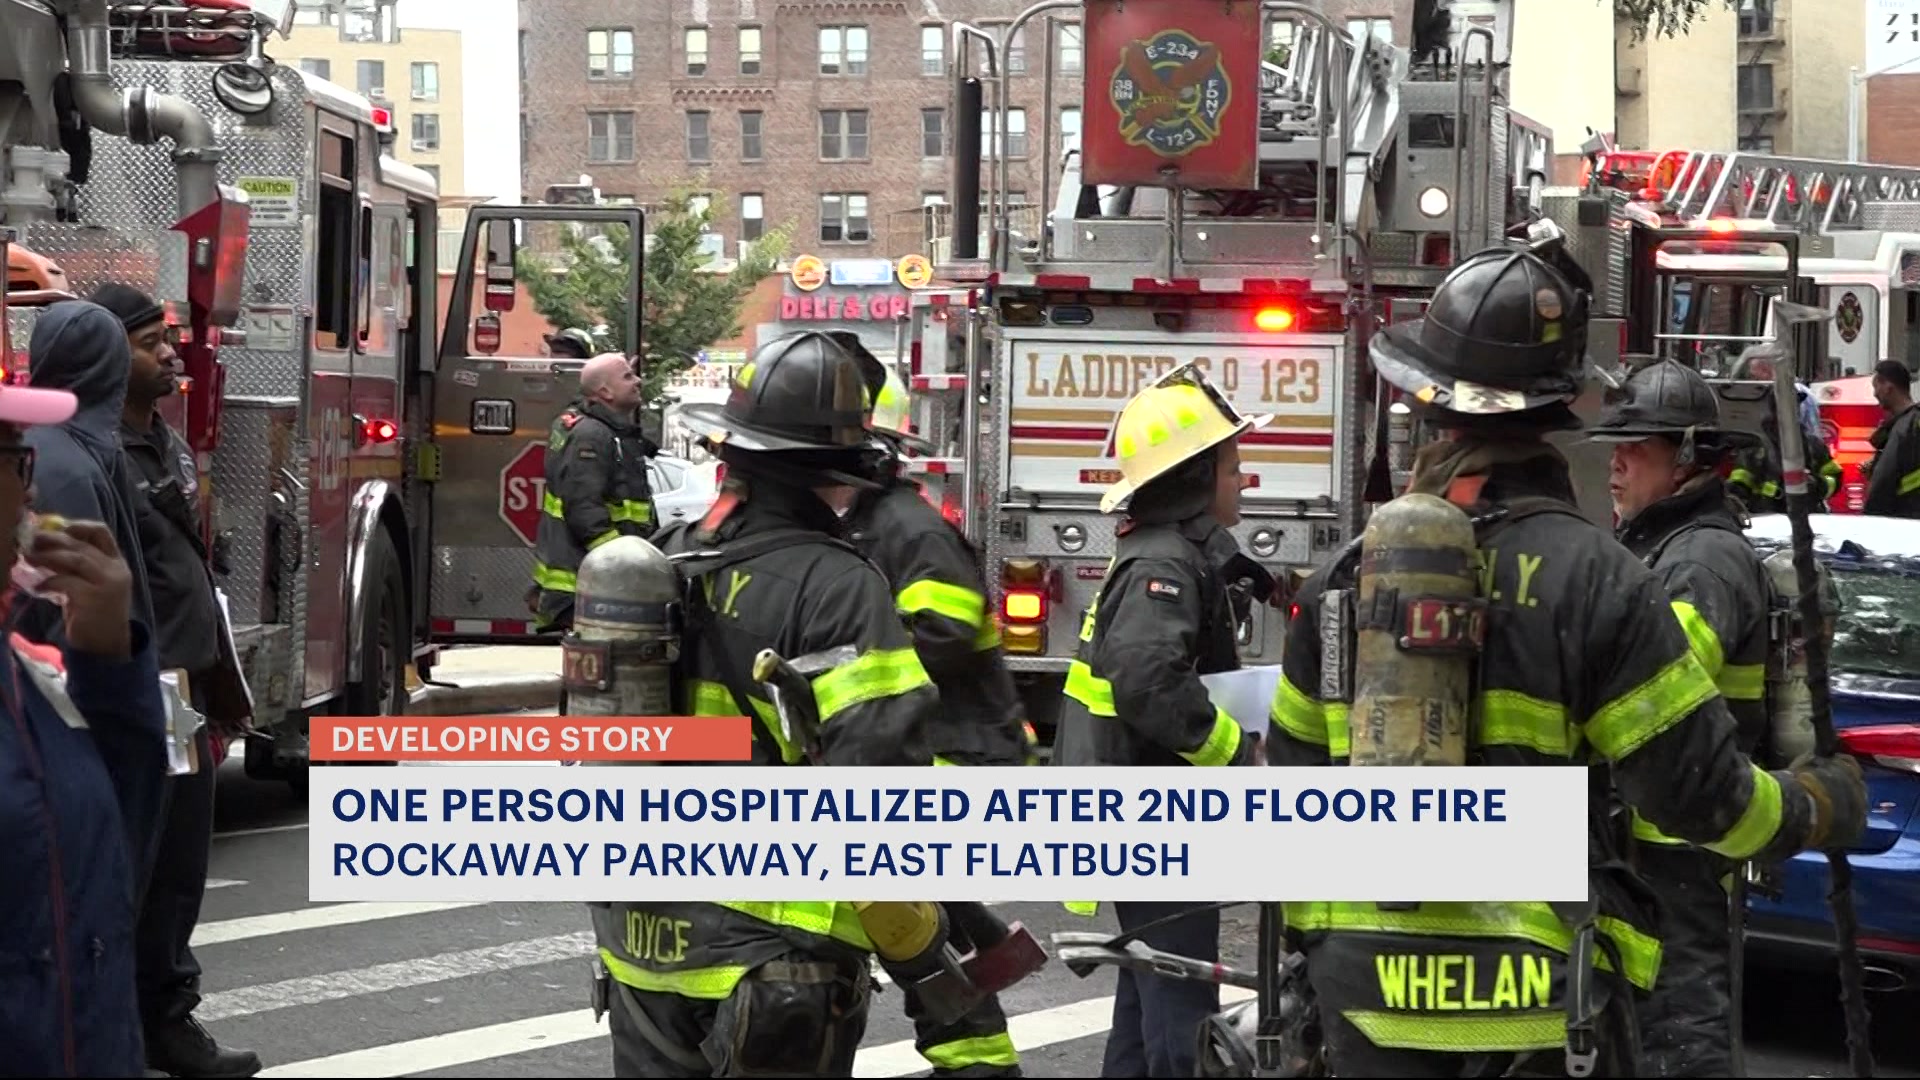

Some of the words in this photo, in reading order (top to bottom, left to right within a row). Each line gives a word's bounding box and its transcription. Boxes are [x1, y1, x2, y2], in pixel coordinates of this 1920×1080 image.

[1145, 42, 1199, 60] E-234
[1146, 128, 1196, 147] L-123
[243, 181, 292, 194] CAUTION
[781, 295, 838, 319] DELI
[843, 294, 861, 319] &
[870, 294, 912, 320] GR
[1261, 358, 1320, 402] 123
[622, 911, 693, 964] JOYCE
[1376, 953, 1552, 1010] WHELAN
